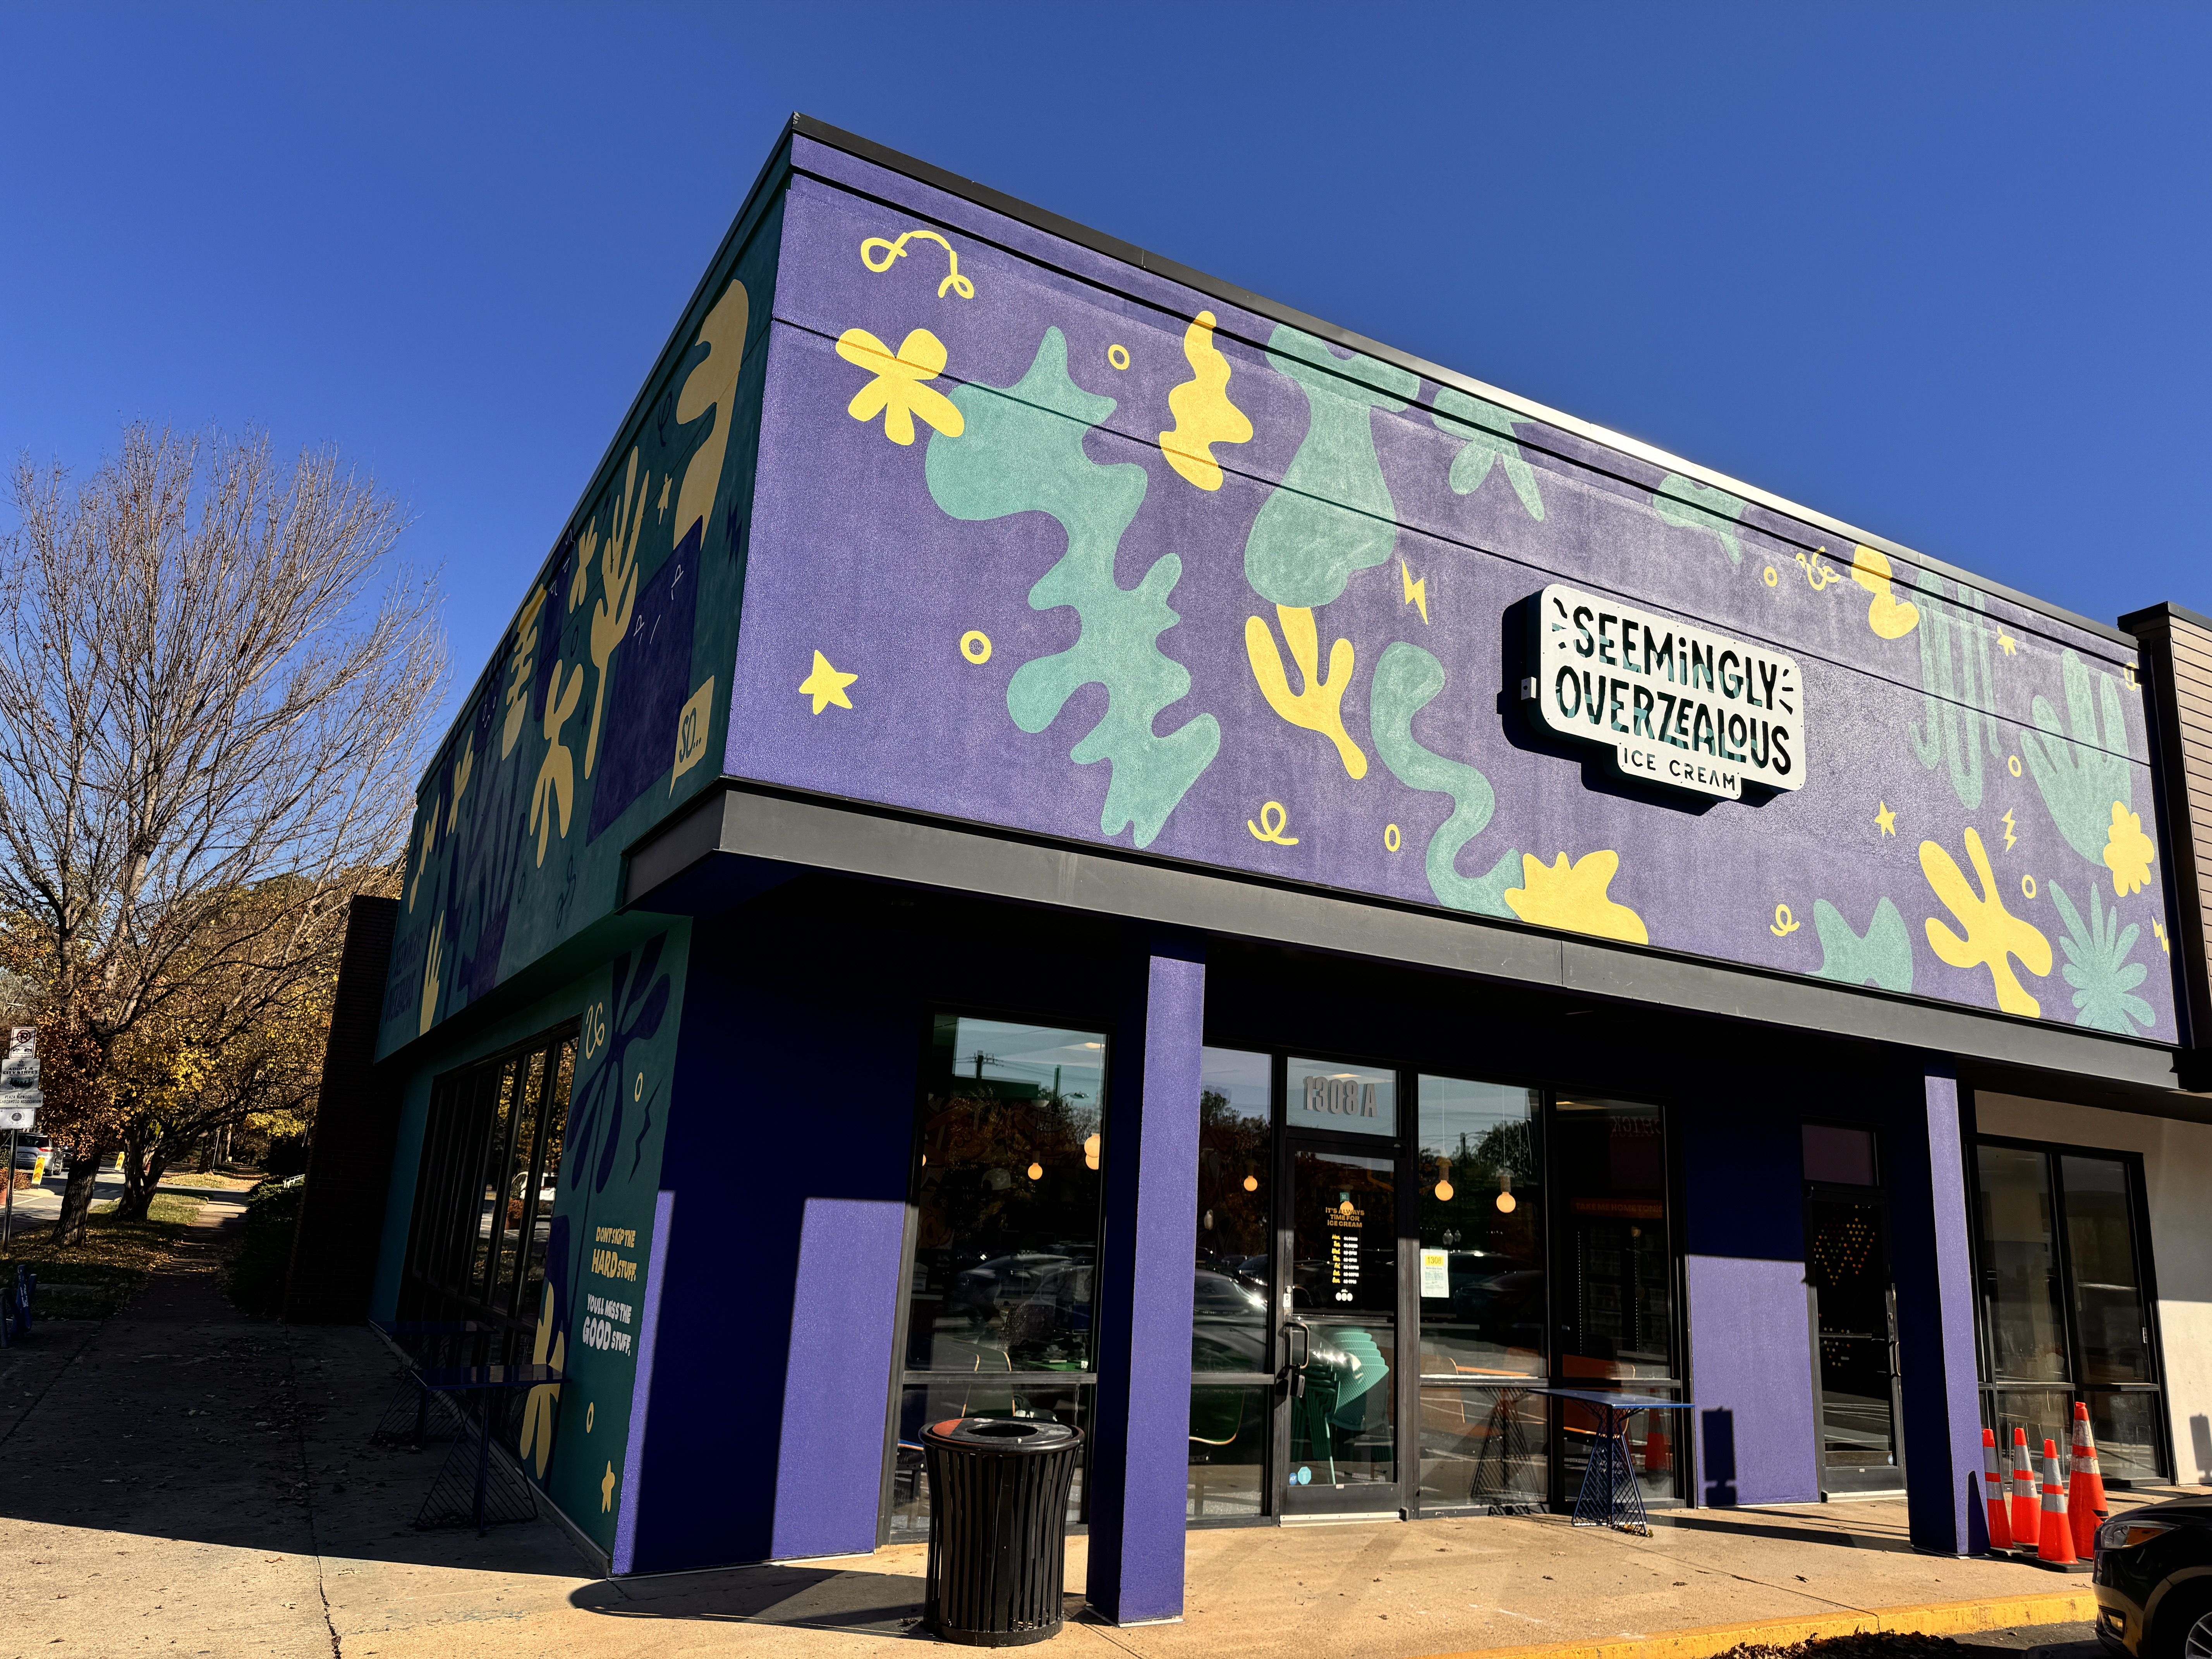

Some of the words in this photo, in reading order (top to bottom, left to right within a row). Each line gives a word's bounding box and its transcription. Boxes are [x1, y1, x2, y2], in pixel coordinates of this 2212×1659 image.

[1556, 665, 1791, 775] OVERZEALOUS
[1624, 747, 1656, 771] ICE
[1670, 760, 1736, 791] CREAM
[1303, 1076, 1358, 1115] 1308
[1360, 1083, 1378, 1117] A
[625, 1230, 636, 1248] THE
[591, 1249, 618, 1278] HARD
[617, 1260, 637, 1282] STUFF.
[620, 1303, 632, 1324] THE
[582, 1316, 611, 1350] GOOD
